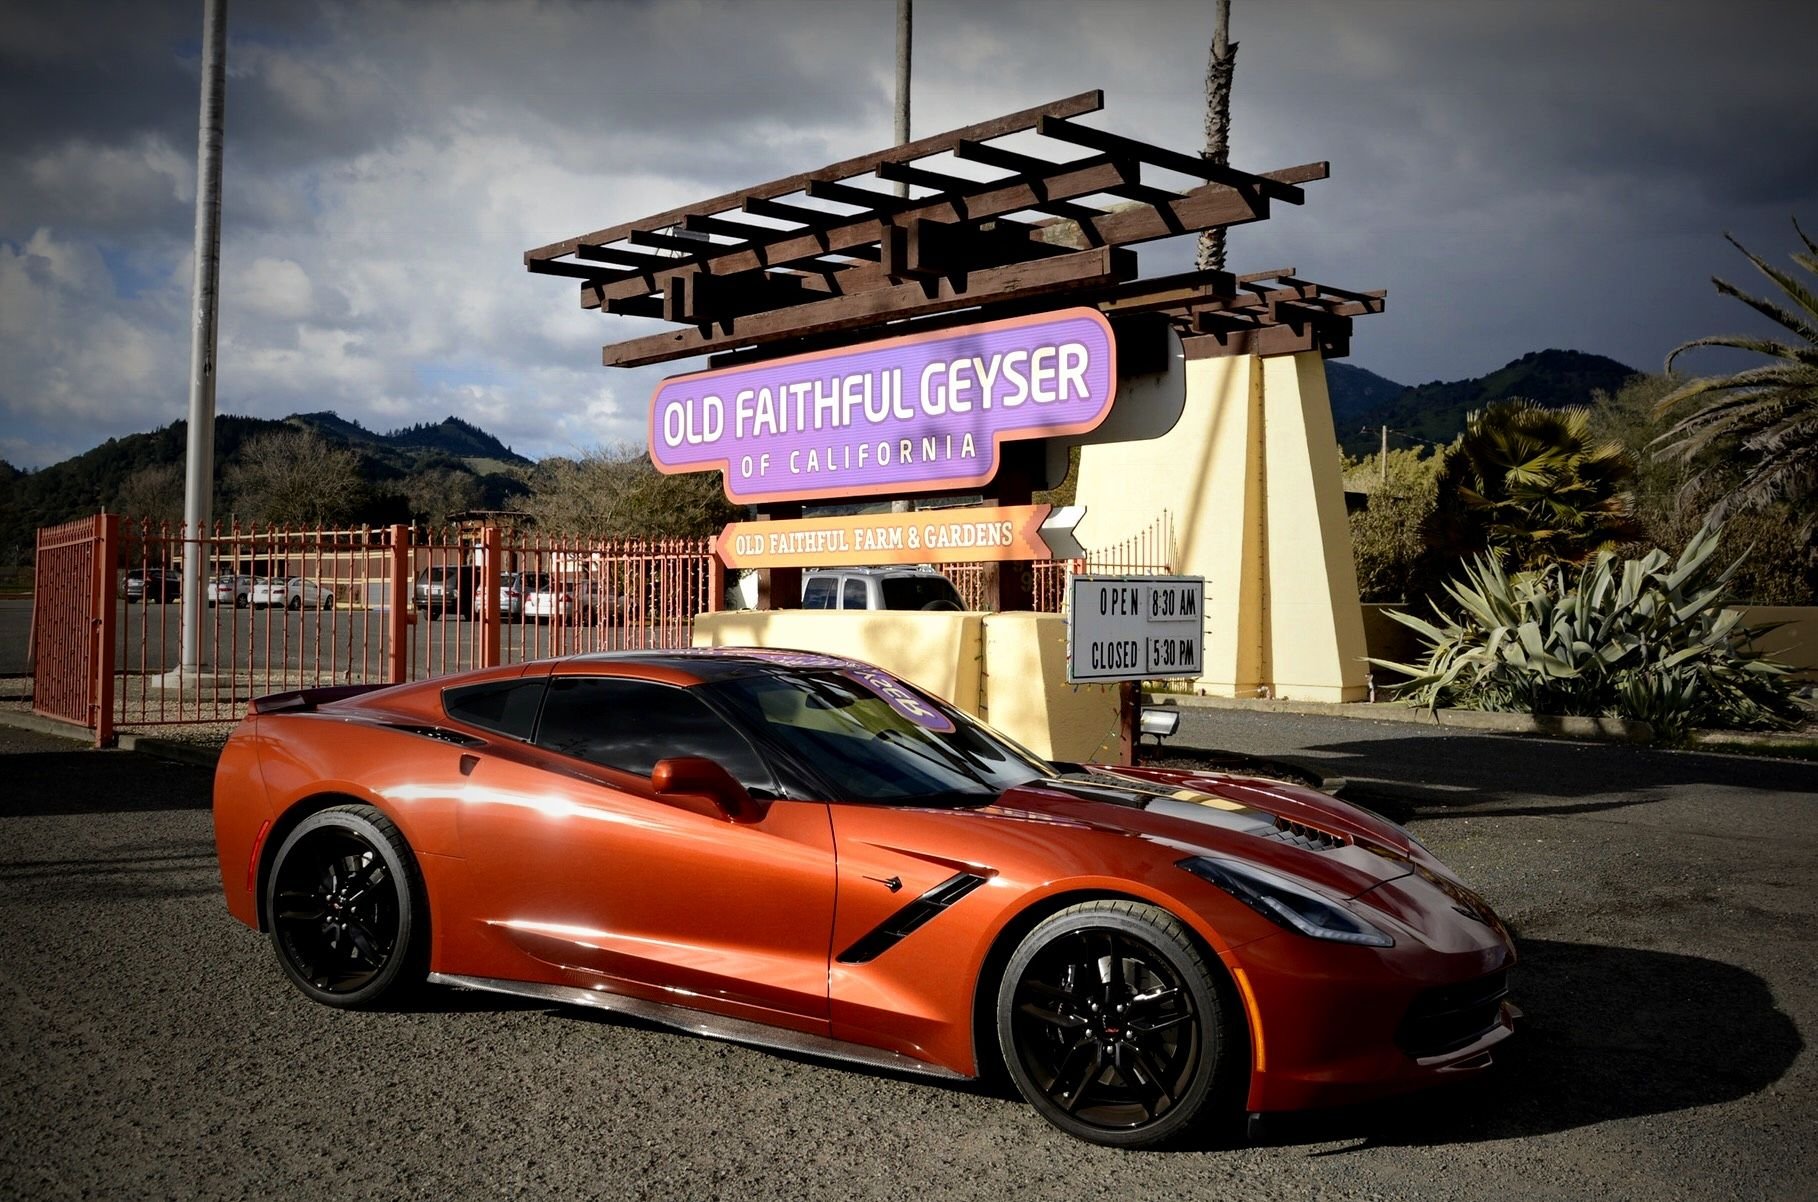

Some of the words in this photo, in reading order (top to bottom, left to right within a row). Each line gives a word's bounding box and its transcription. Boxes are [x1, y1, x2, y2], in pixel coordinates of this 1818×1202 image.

[663, 395, 724, 448] OLD
[735, 369, 914, 439] FAITHFUL
[920, 342, 1090, 417] GEYSER
[741, 452, 771, 479] OF
[789, 433, 977, 475] CALIFORNIA
[735, 534, 765, 556] OLD
[769, 528, 849, 554] FAITHFUL
[854, 525, 905, 551] FARM
[907, 526, 920, 548] &
[924, 521, 1013, 548] GARDENS
[1100, 587, 1139, 616] OPEN
[1152, 589, 1175, 616] 8:30
[1179, 589, 1196, 616] AM
[1091, 640, 1138, 670] CLOSED
[1153, 639, 1176, 666] 5:30
[1179, 639, 1194, 666] PM
